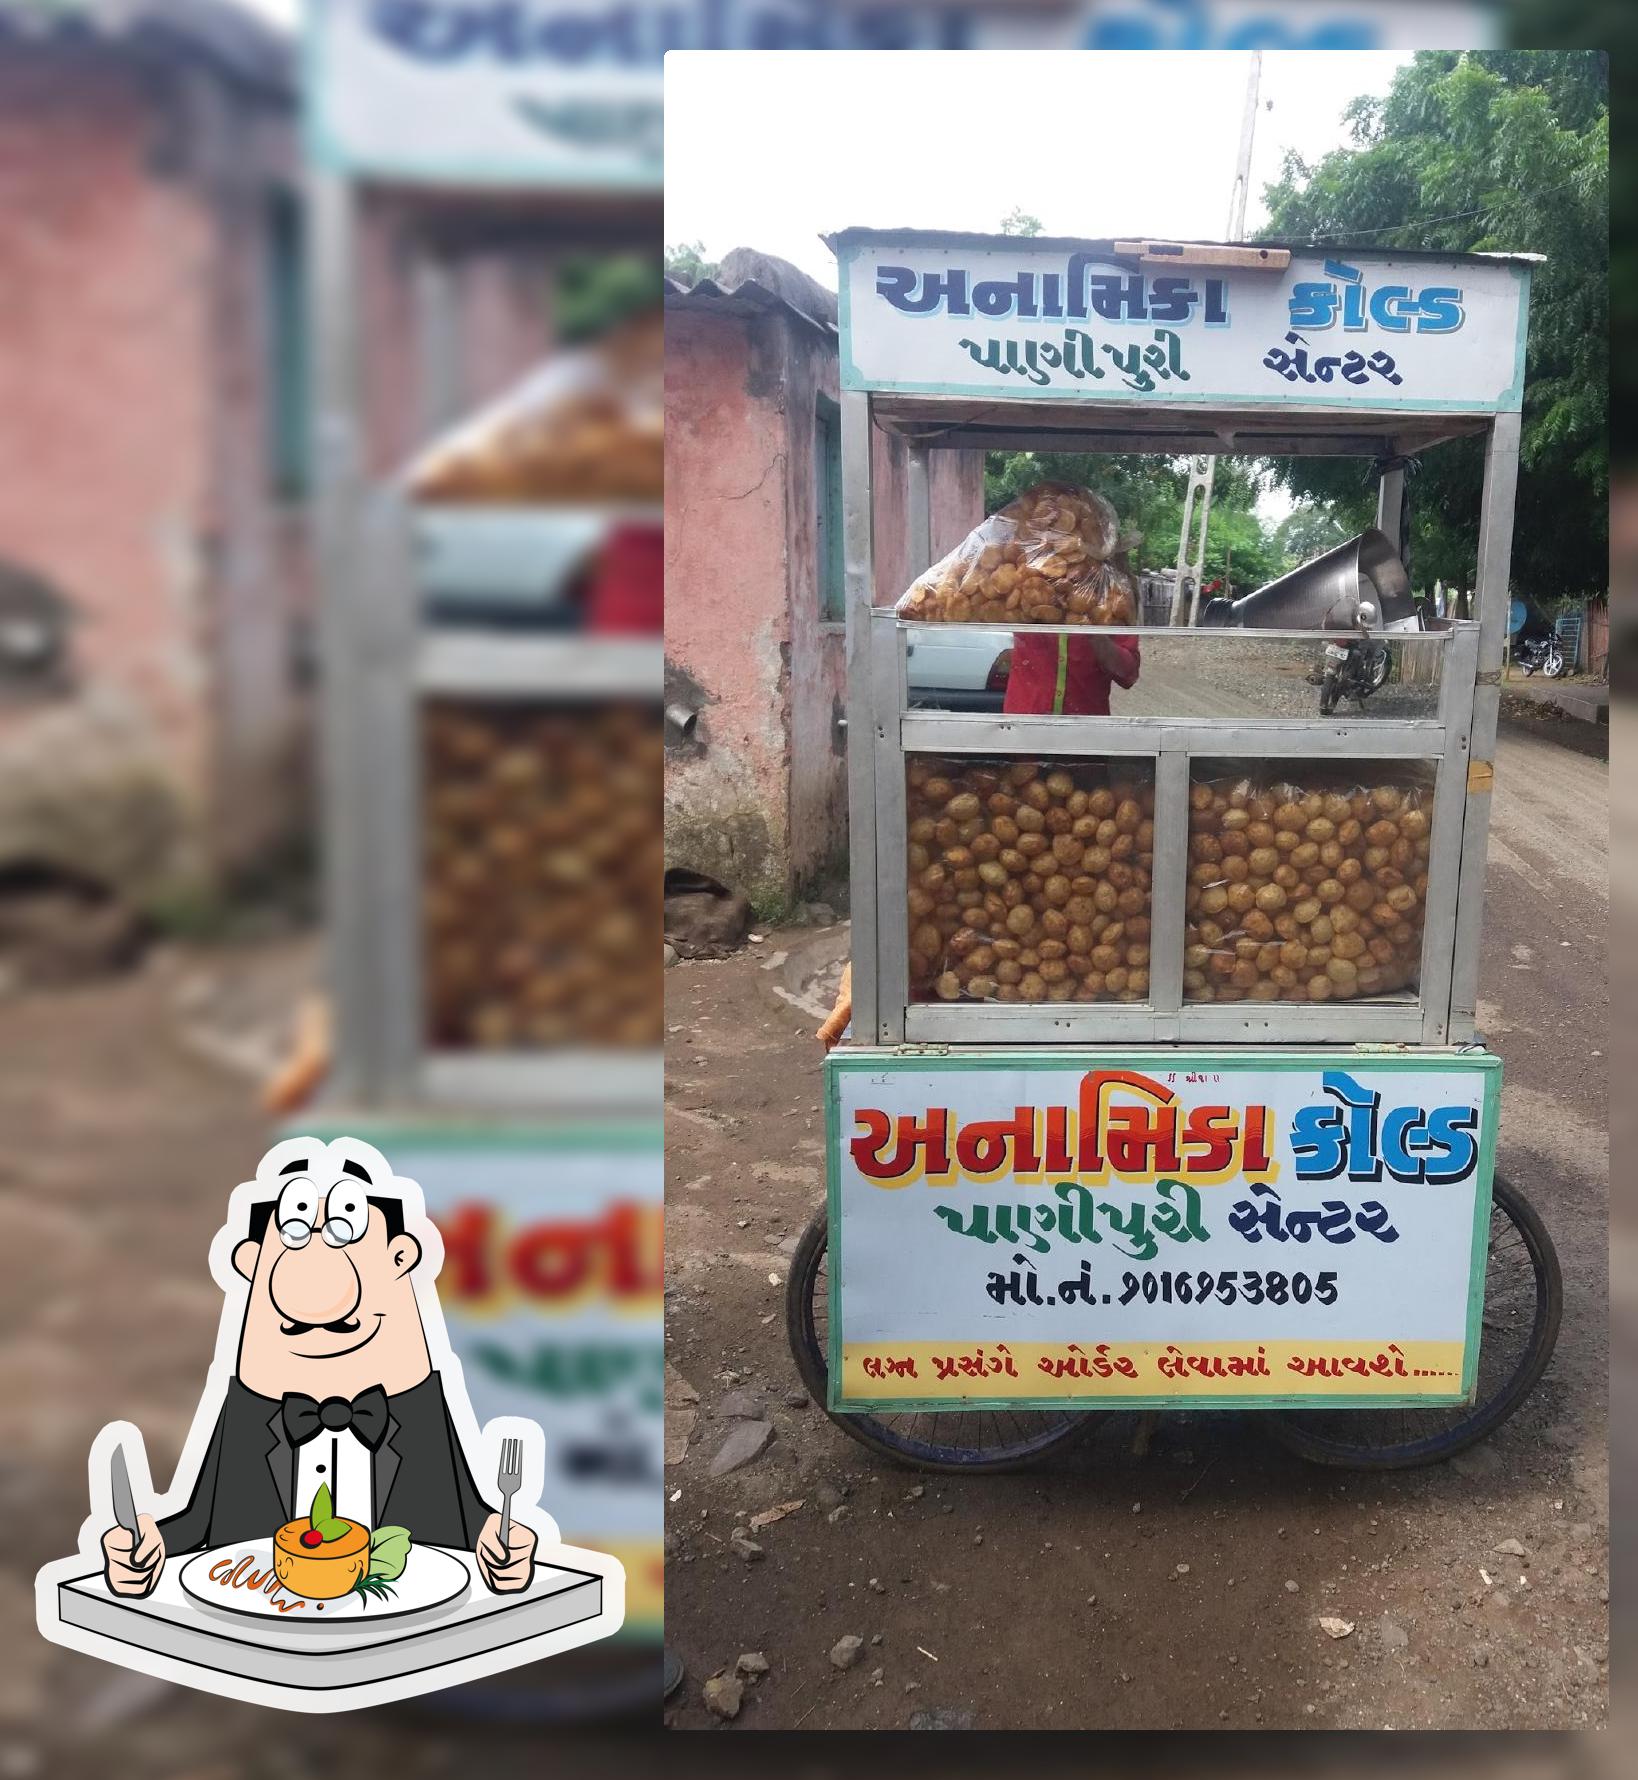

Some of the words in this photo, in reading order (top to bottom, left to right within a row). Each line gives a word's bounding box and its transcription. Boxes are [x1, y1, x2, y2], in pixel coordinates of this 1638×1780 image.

[876, 252, 1232, 328] અનામિકા
[1288, 258, 1466, 334] કોલ્ડ
[958, 328, 1190, 392] પાણીપુરી
[1263, 331, 1404, 386] સેન્ટર
[850, 1070, 1281, 1188] અનામિકા
[1289, 1071, 1479, 1185] કોલ્ડ
[933, 1179, 1211, 1261] પાણીપુરી
[1229, 1182, 1400, 1244] સેન્ટર
[863, 1356, 919, 1379] લગ્ન
[931, 1344, 1019, 1381] પ્રસંગે
[1038, 1344, 1139, 1379] ઓર્ડર
[1157, 1345, 1271, 1379] લેવામાં
